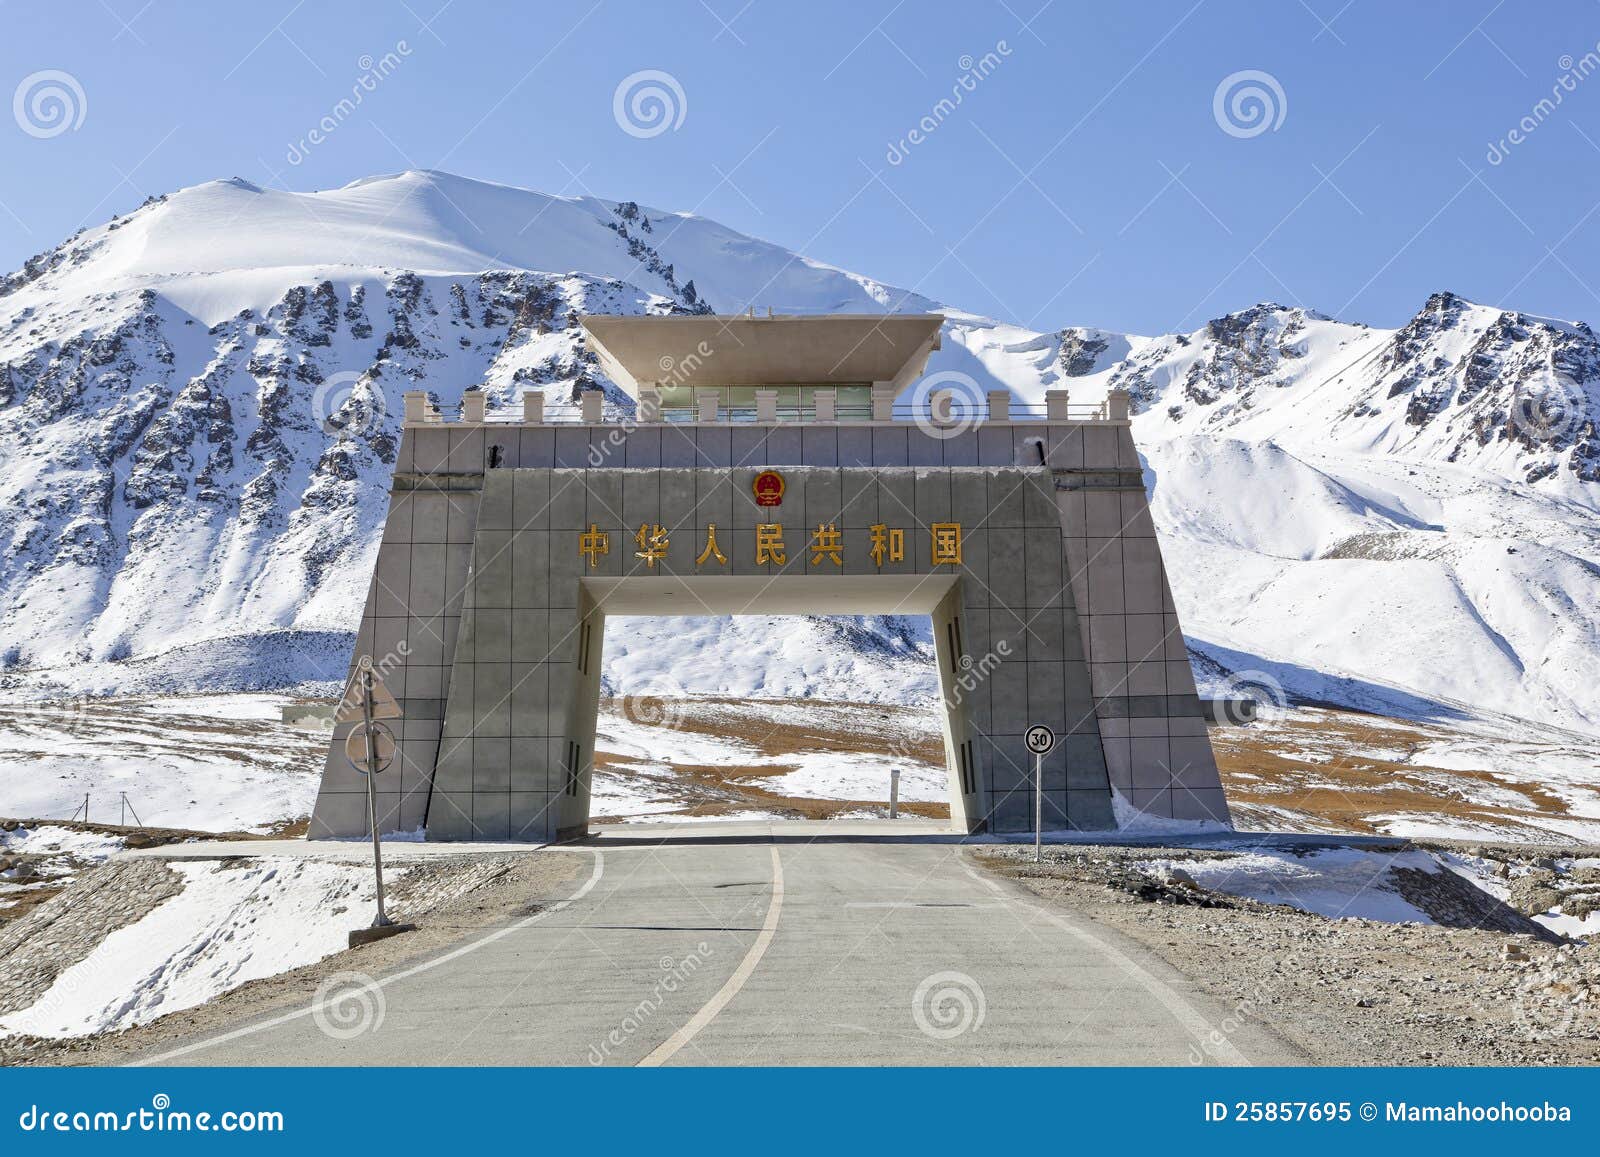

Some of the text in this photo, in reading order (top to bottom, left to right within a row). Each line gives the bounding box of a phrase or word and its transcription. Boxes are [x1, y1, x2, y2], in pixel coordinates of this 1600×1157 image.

[579, 522, 962, 567] 中华人民共和国
[1031, 733, 1047, 746] 30
